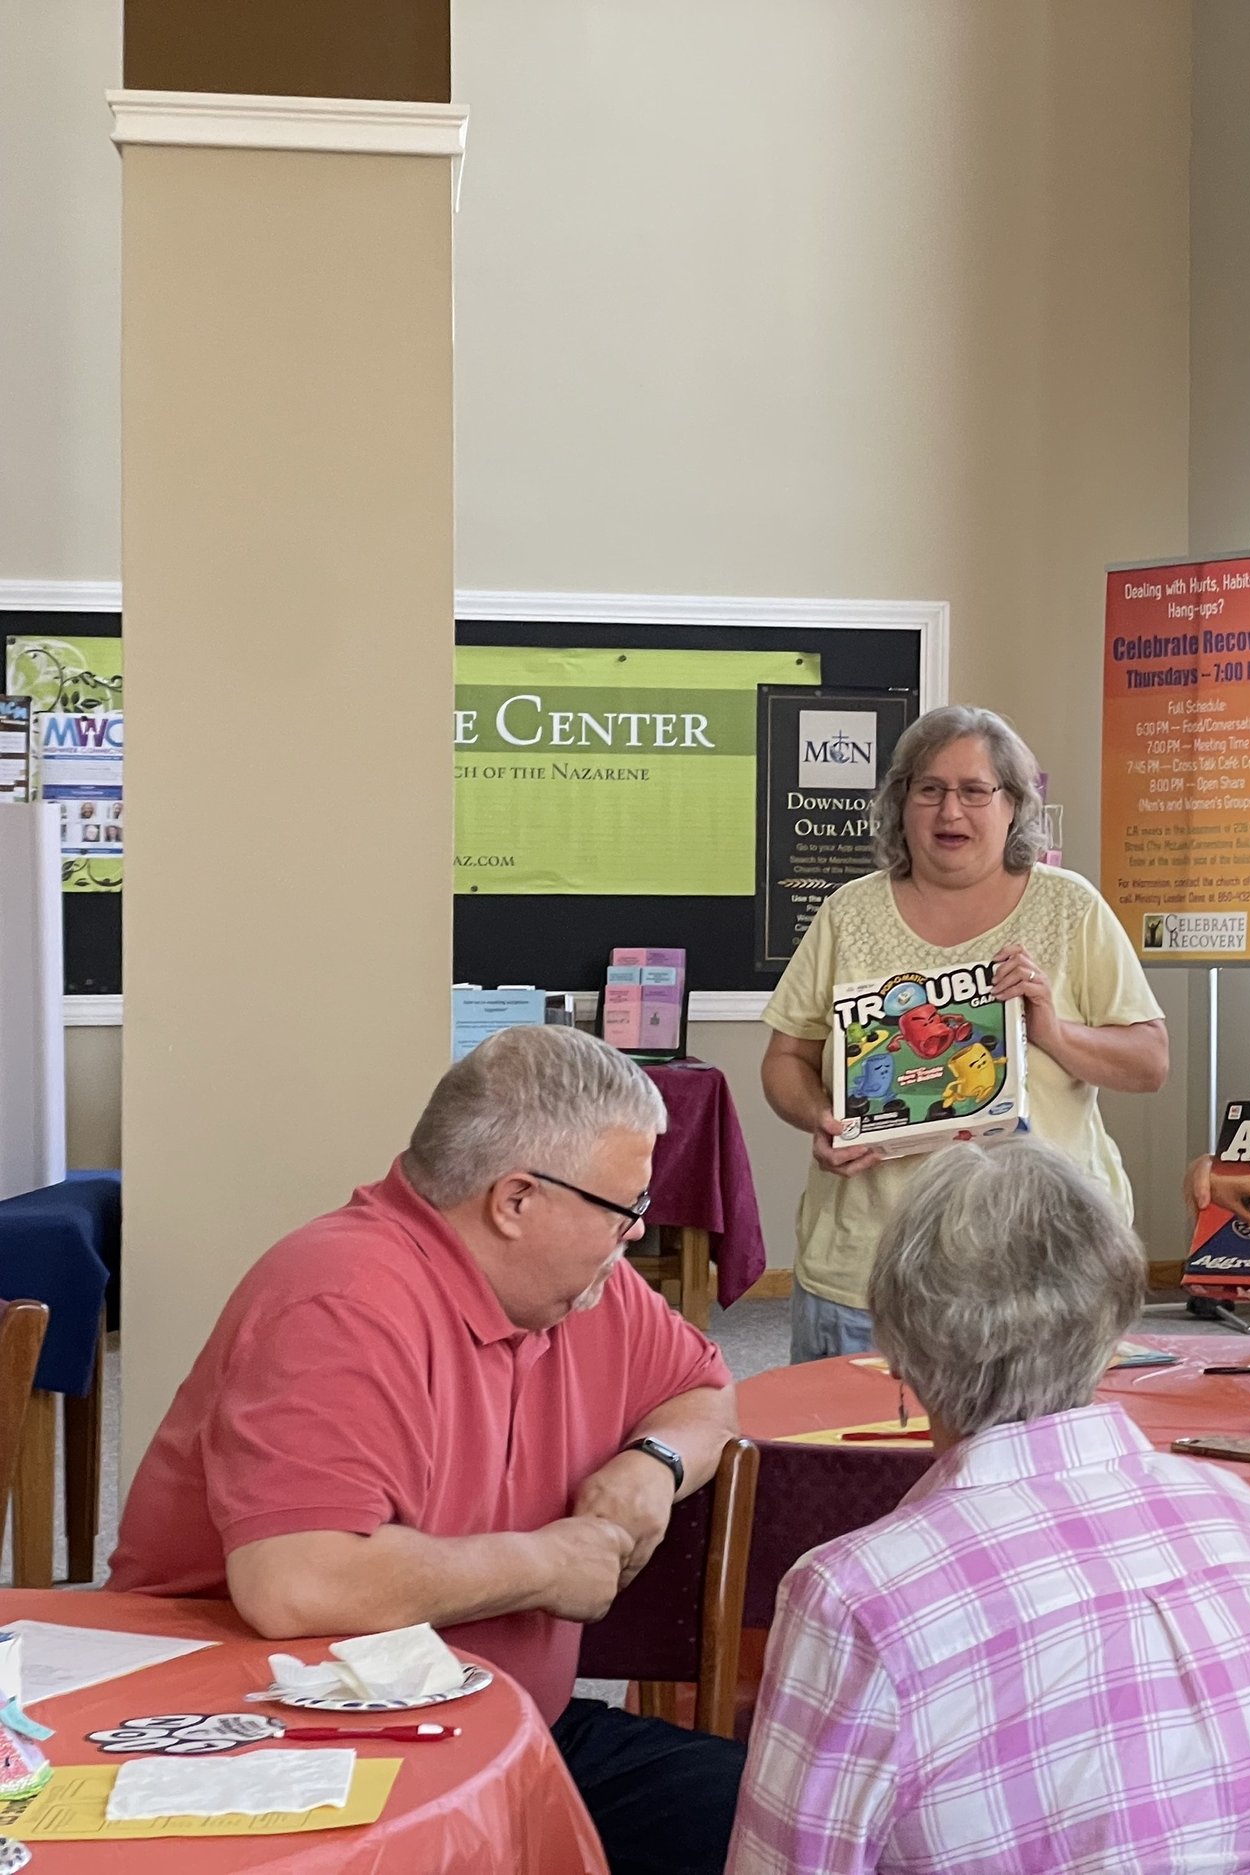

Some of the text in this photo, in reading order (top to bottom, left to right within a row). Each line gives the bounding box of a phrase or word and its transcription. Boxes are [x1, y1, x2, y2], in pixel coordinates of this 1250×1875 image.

[1124, 583, 1162, 600] Dealing
[1166, 581, 1186, 596] with
[1189, 577, 1220, 593] Hurts,
[1168, 598, 1224, 620] Hang-ups?
[1113, 633, 1199, 662] Celebrate
[1126, 667, 1198, 689] Thursdays
[1214, 662, 1243, 683] 7:00
[1168, 699, 1227, 715] Full Schedule
[496, 694, 716, 748] CENTER
[1156, 721, 1169, 735] PM
[1168, 740, 1180, 753] PM
[1194, 738, 1227, 753] Meeting
[1228, 736, 1250, 750] Time
[1172, 758, 1198, 772] Cross
[1196, 776, 1219, 793] Open
[1220, 776, 1246, 789] Share
[787, 792, 876, 811] DOWNLOA
[1166, 798, 1182, 811] and
